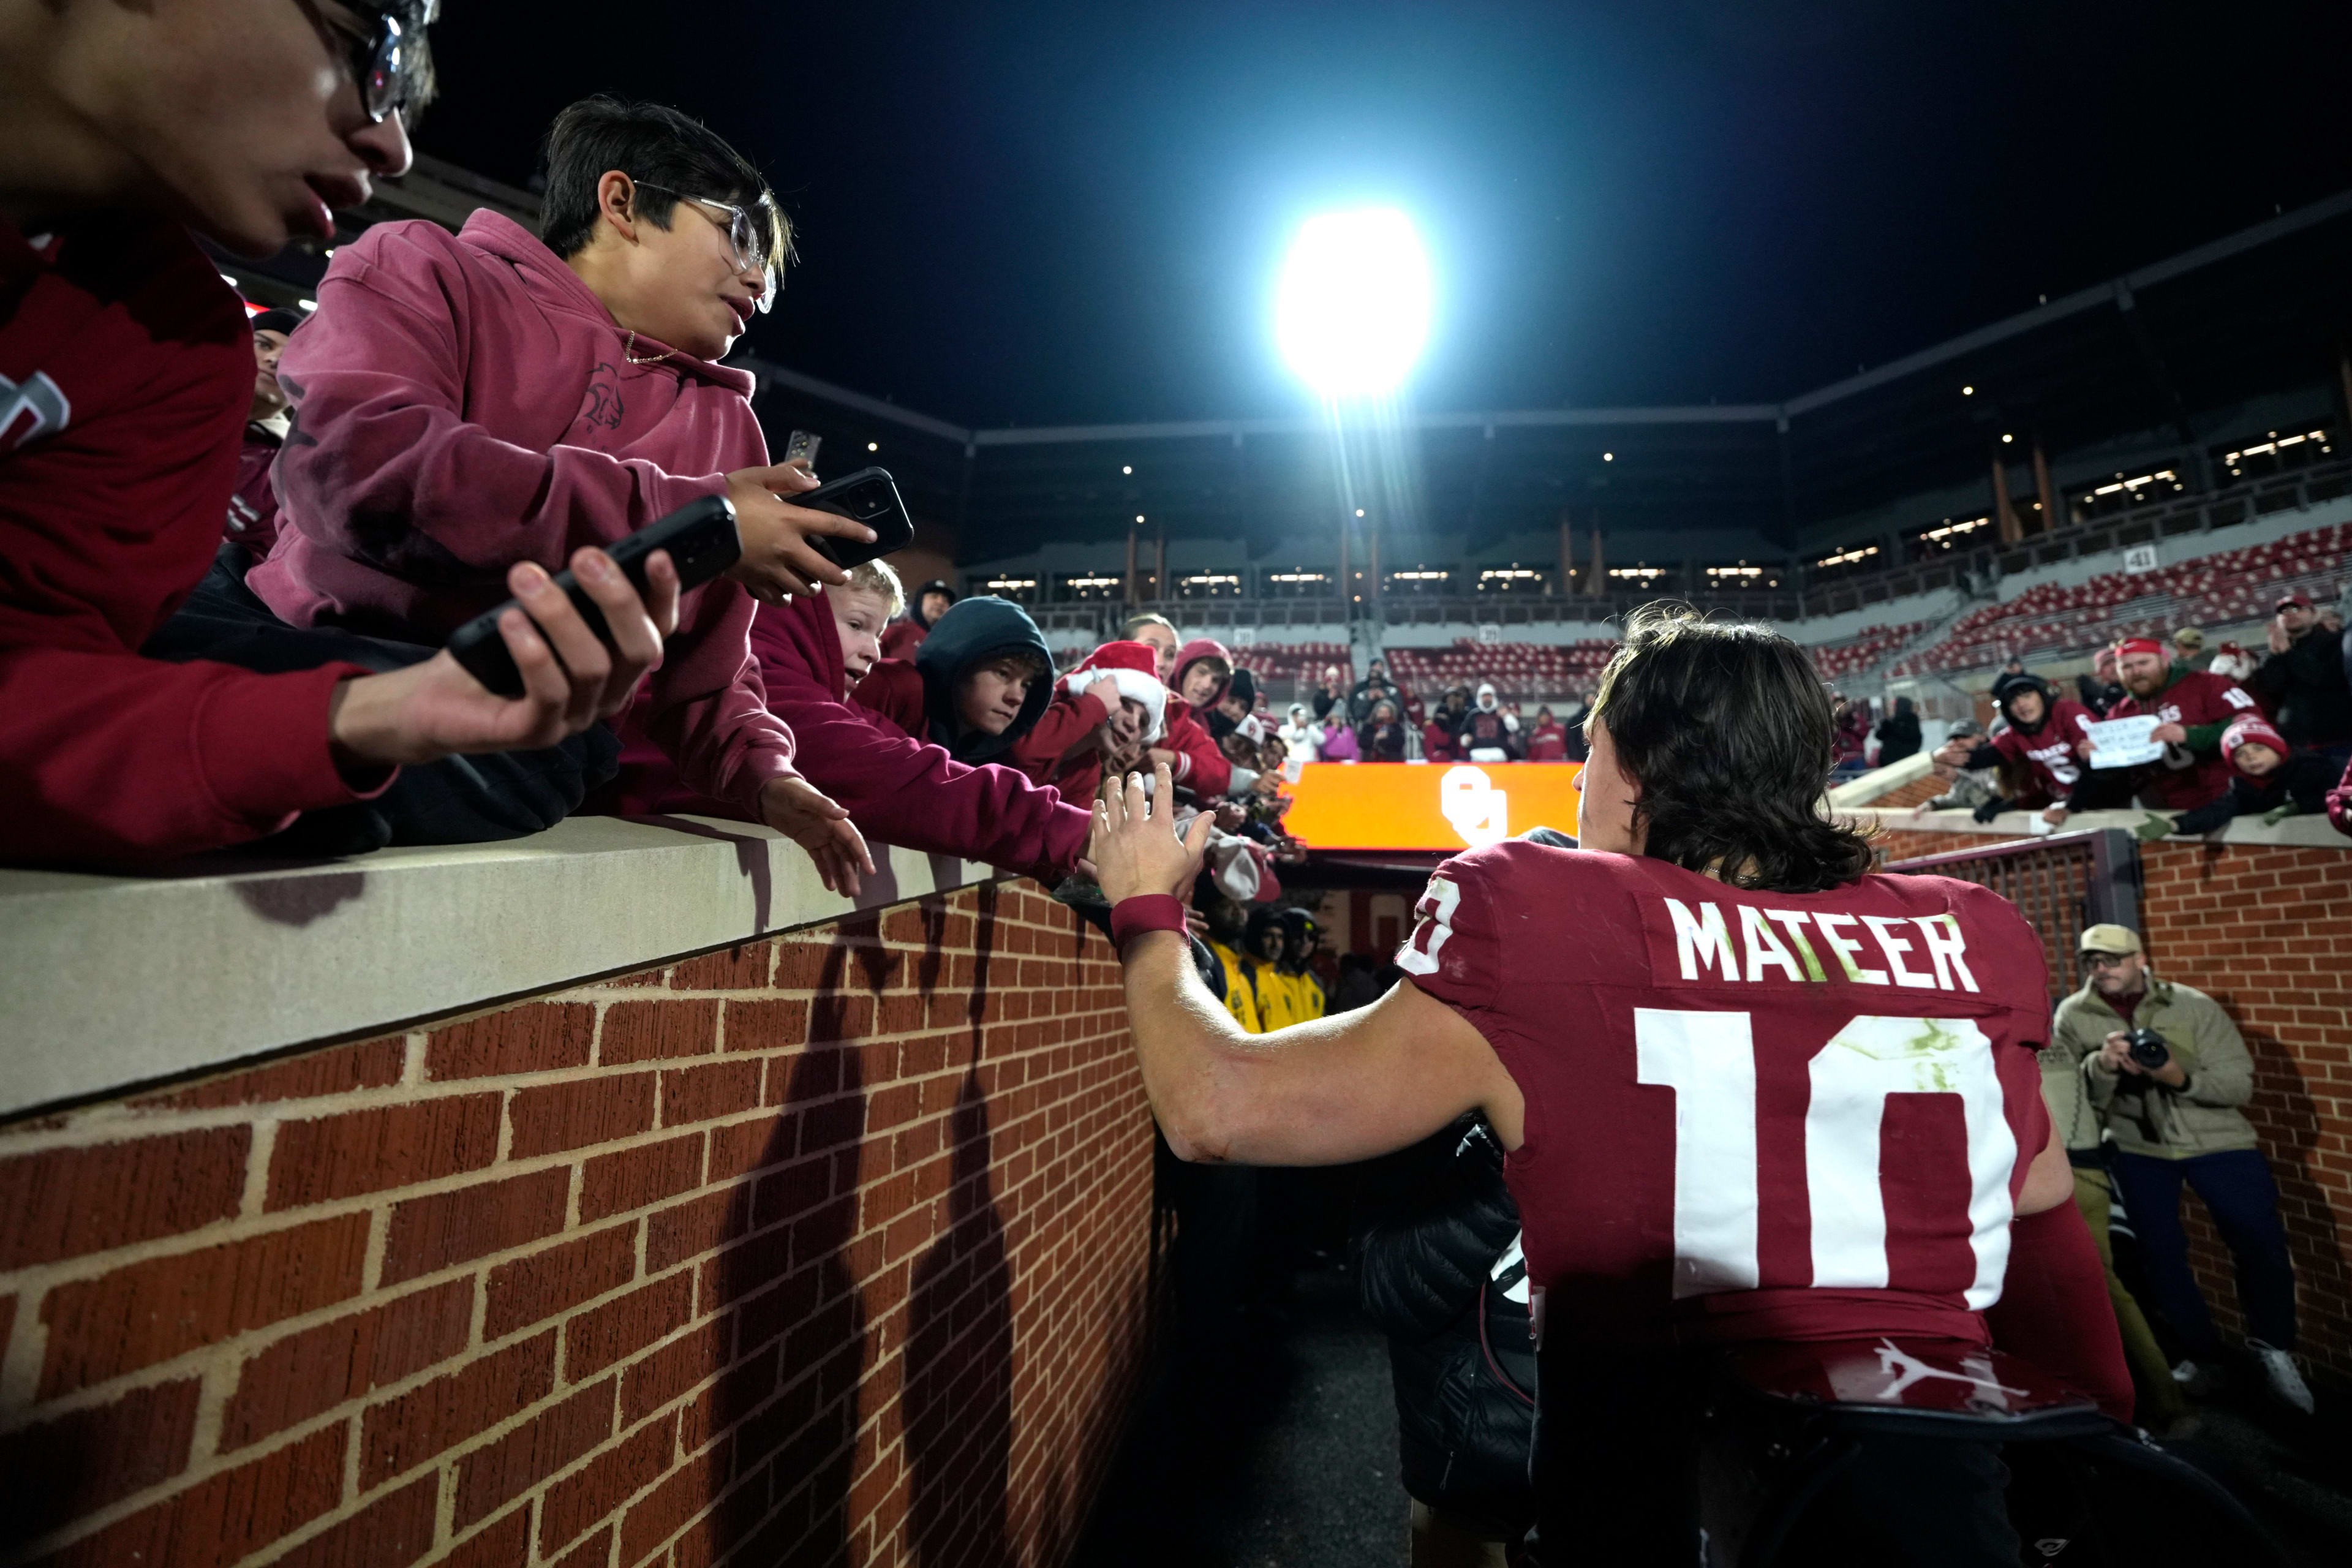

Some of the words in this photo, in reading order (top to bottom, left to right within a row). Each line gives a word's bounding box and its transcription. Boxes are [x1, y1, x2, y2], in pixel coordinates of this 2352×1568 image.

[2130, 552, 2150, 567] 41
[2222, 687, 2255, 709] 10
[1663, 897, 1980, 992] MATEER
[1634, 1008, 2018, 1311] 10
